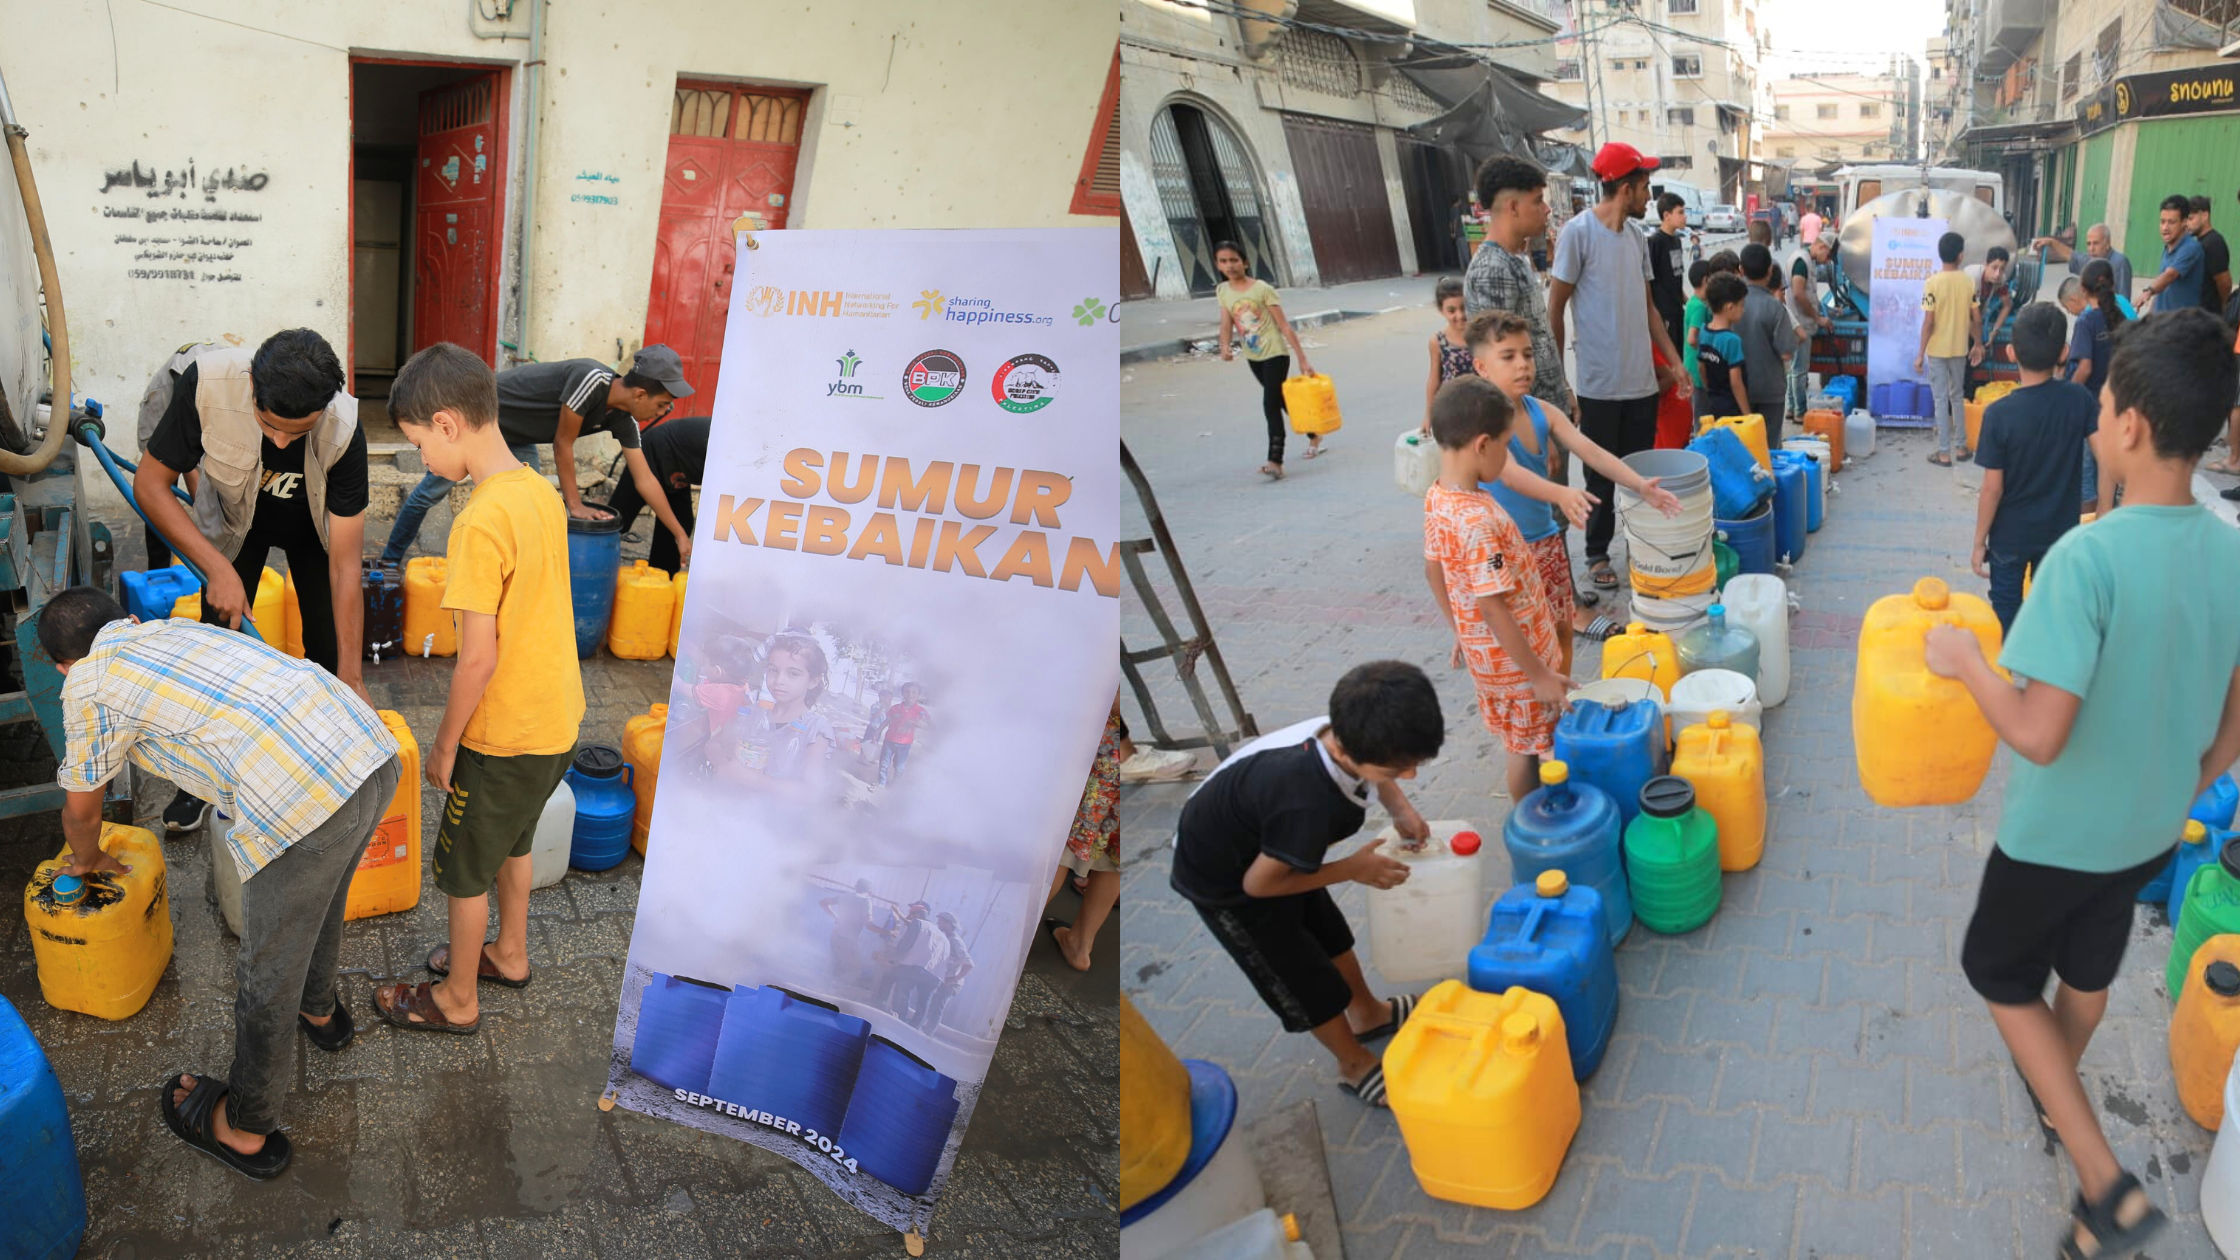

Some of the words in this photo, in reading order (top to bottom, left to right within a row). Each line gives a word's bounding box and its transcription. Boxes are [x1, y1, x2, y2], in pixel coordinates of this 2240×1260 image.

[2170, 78, 2234, 103] snounu
[1874, 268, 1938, 281] KEBAIKA
[786, 290, 844, 318] INH
[845, 292, 891, 300] International
[886, 301, 899, 309] For
[948, 296, 991, 309] sharing
[945, 306, 1053, 327] happiness.org
[826, 379, 863, 397] ybm
[911, 370, 957, 387] BPK
[260, 469, 304, 499] IKE
[779, 447, 1073, 529] SUMUR
[713, 493, 1120, 599] KEBAIKAN
[674, 1088, 801, 1136] SEPTEMBER
[804, 1128, 859, 1174] 2024
